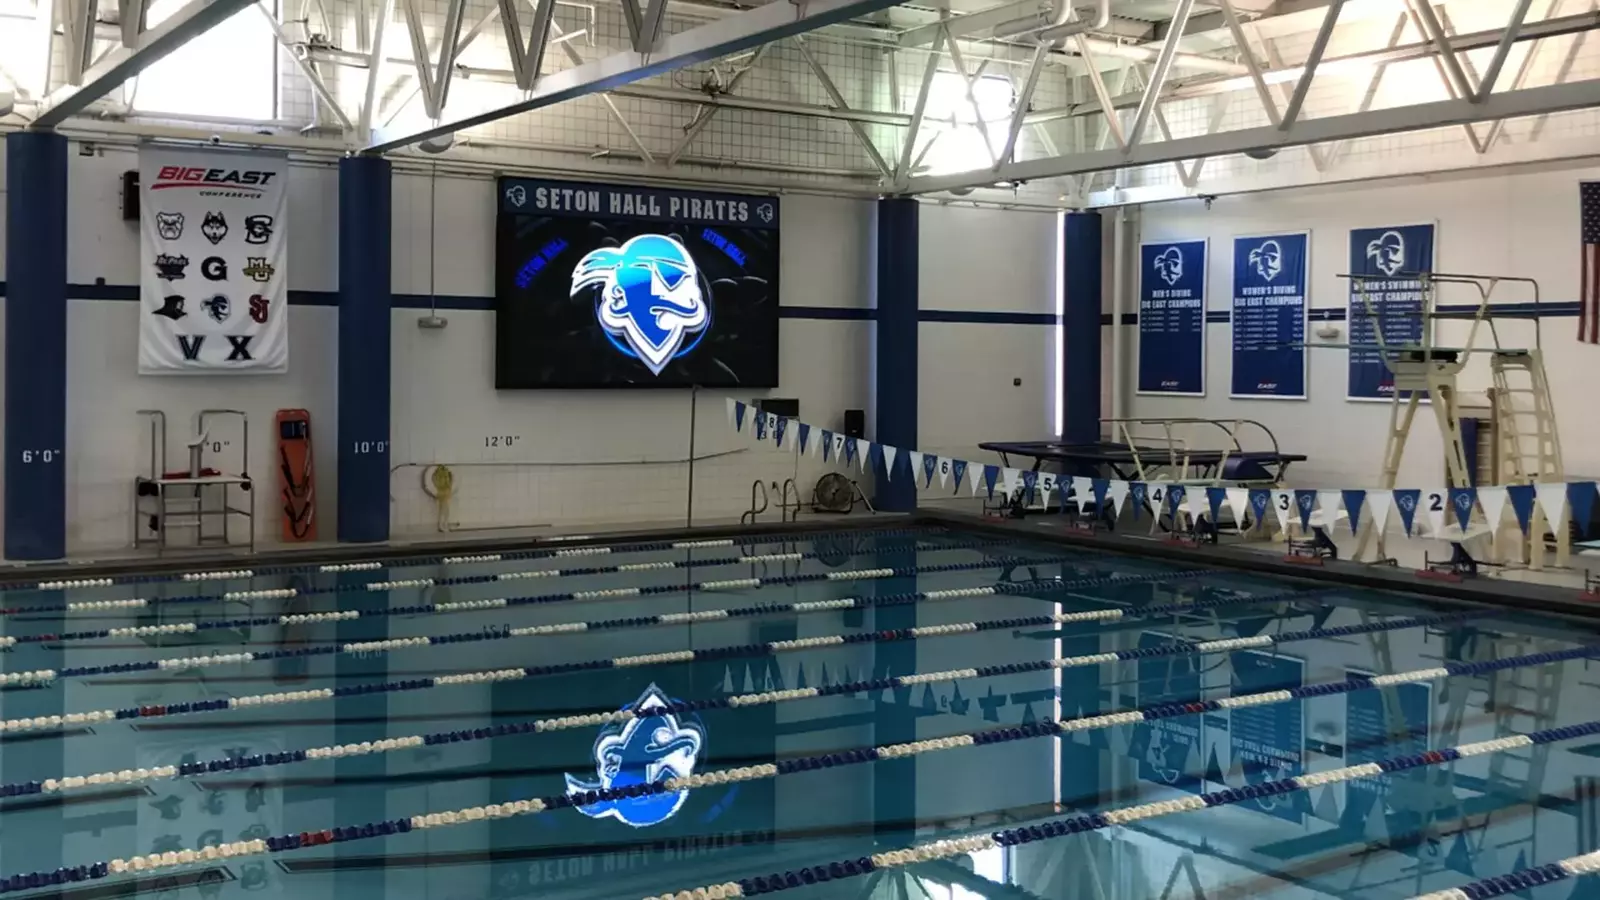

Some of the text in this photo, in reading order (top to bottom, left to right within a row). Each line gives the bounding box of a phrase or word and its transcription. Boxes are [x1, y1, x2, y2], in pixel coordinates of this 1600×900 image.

[199, 190, 262, 199] CONFERENCE
[536, 187, 749, 222] SETON HALL PIRATES
[1242, 285, 1296, 296] WOMEN'S DIVING
[1353, 281, 1387, 291] WMEN'S
[1152, 289, 1192, 298] MEN'S DIVING
[1168, 299, 1201, 309] CHAMPIONS
[1247, 297, 1263, 306] EAST
[1264, 295, 1303, 306] CHAMPIONS
[176, 335, 207, 361] V
[224, 335, 255, 361] X
[769, 416, 777, 429] 8
[836, 437, 843, 449] 7
[941, 461, 949, 475] 6
[1043, 477, 1052, 492] 5
[1152, 488, 1163, 504] 4
[1279, 494, 1290, 511] 3
[1429, 493, 1443, 512] 2
